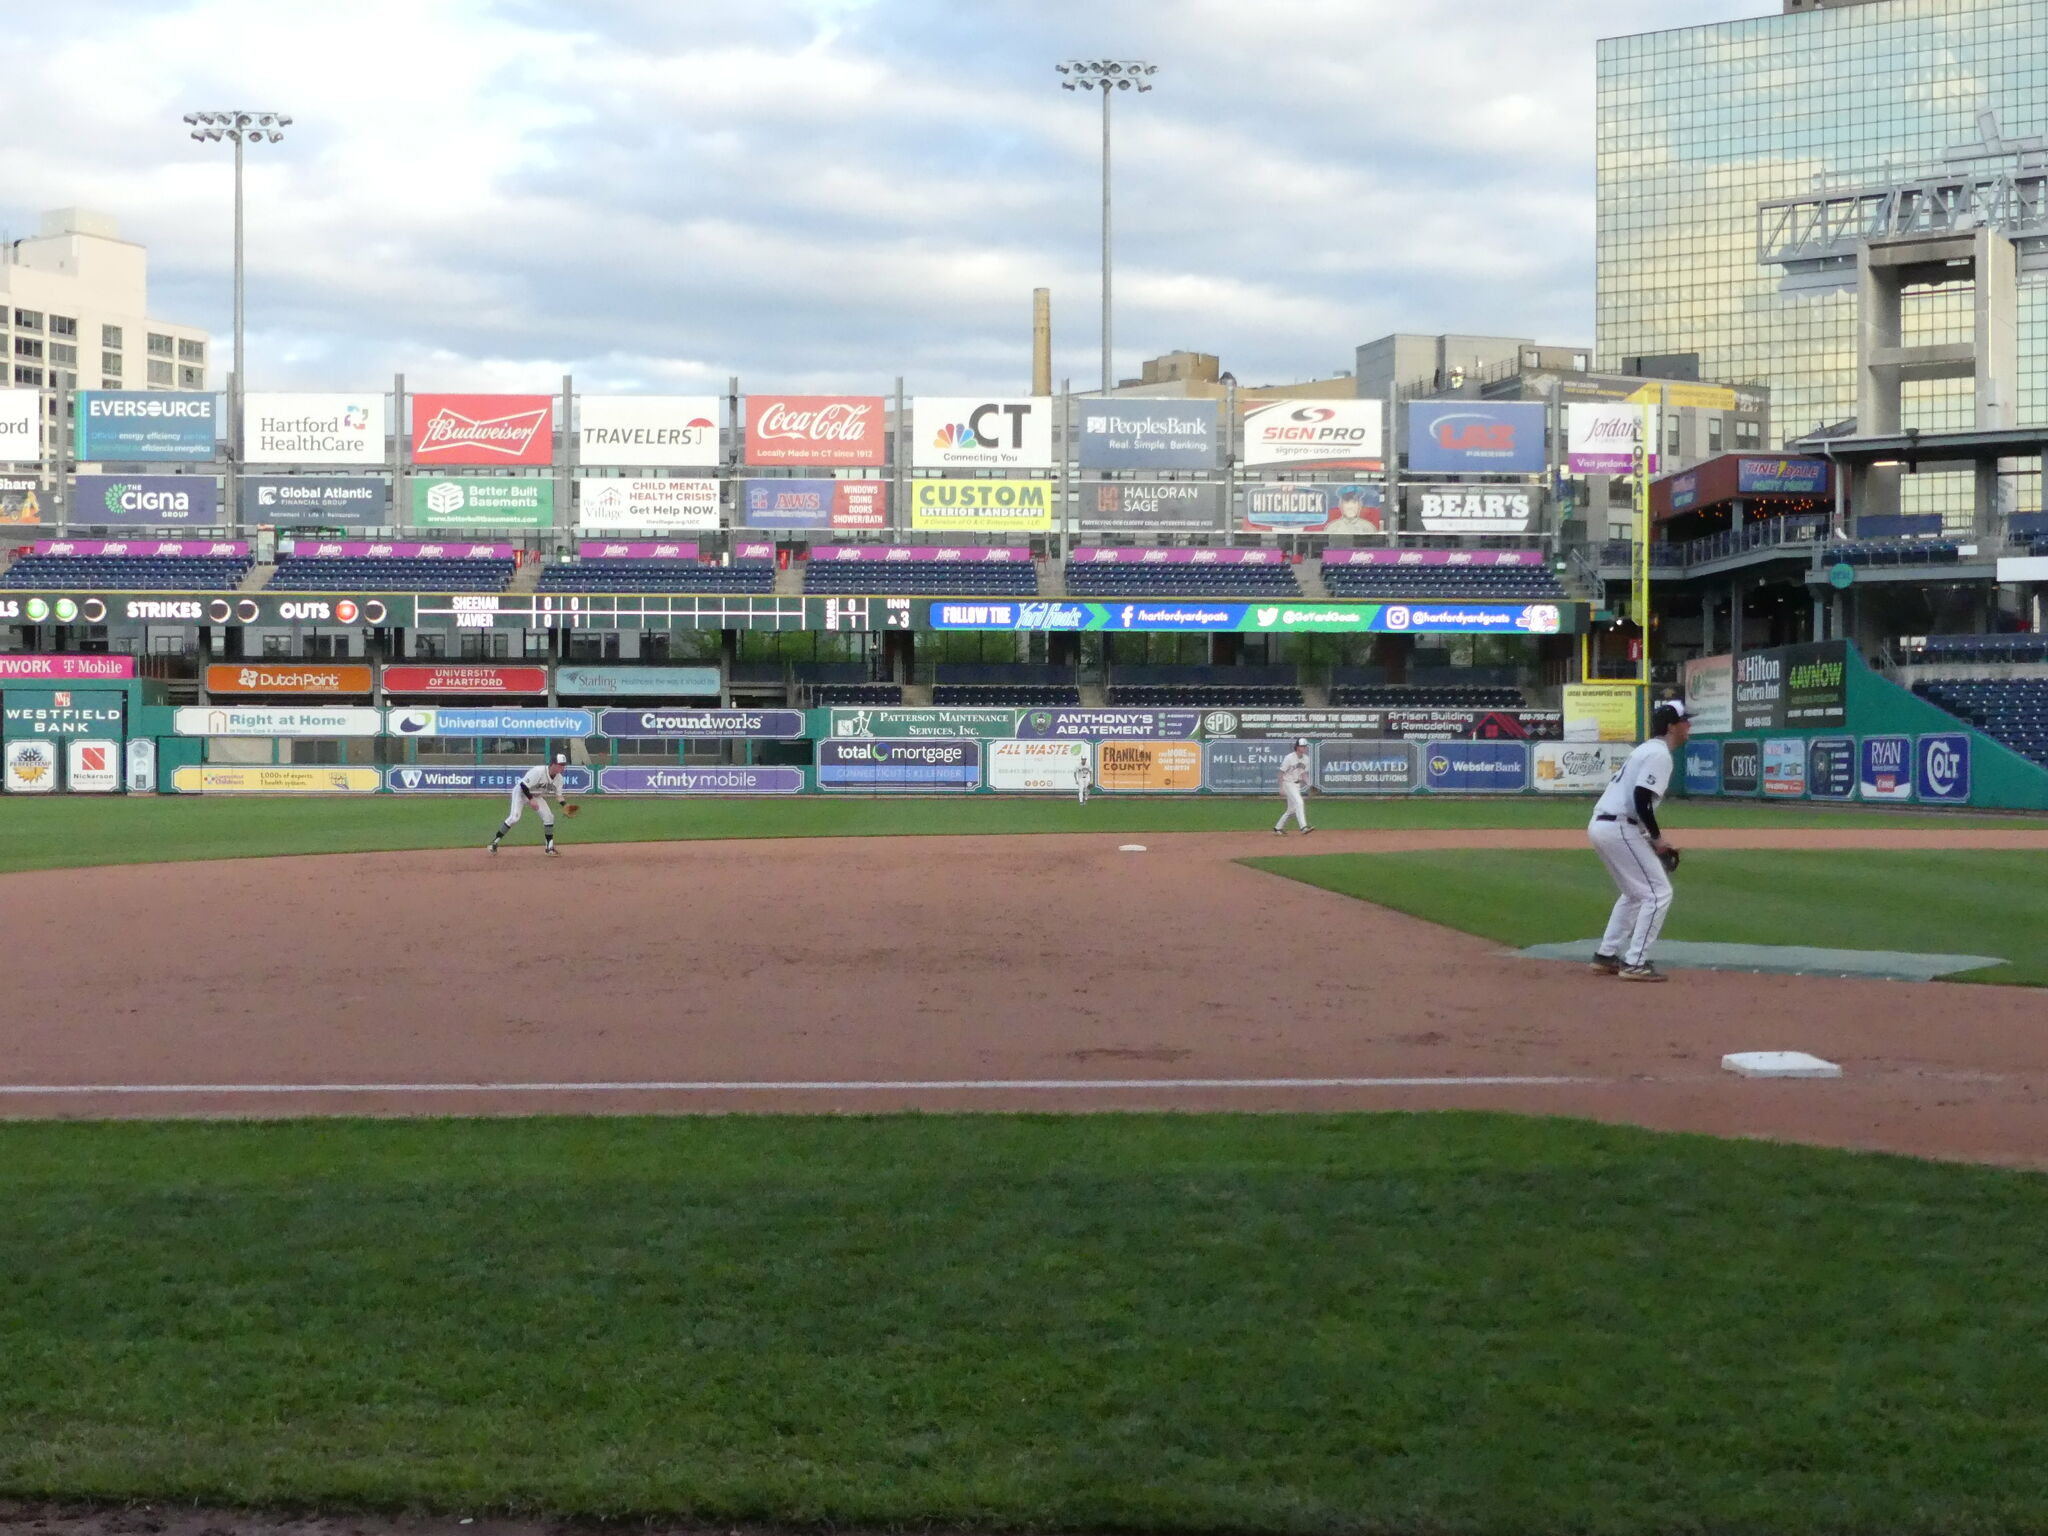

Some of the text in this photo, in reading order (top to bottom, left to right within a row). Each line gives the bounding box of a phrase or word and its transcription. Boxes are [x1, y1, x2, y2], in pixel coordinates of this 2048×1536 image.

[90, 401, 210, 417] EVERSOURCE
[260, 417, 338, 432] Hartford
[757, 403, 872, 440] Coca-Cola
[969, 403, 1032, 448] CT
[1110, 416, 1206, 439] PeoplesBank
[428, 418, 534, 440] Budweiser
[1262, 427, 1366, 440] SIGN PRO
[119, 432, 180, 441] energy efficiency
[584, 428, 692, 444] TRAVELERS
[1440, 424, 1515, 450] LAZ
[260, 435, 364, 451] HealthCare
[1110, 440, 1208, 452] Real. Simple. Banking.
[757, 450, 785, 458] Locally
[788, 450, 809, 458] Made
[821, 450, 832, 458] CT
[834, 450, 854, 458] since
[856, 450, 872, 458] 1912
[944, 453, 1018, 462] Connecting You
[1577, 459, 1596, 467] Visit
[470, 486, 538, 496] Better Built
[632, 482, 714, 490] CHILD MENTAL
[844, 486, 878, 494] WINDOWS
[280, 487, 372, 498] Global Atlantic
[630, 492, 717, 501] HEALTH CRISIS?
[920, 486, 1044, 506] CUSTOM
[1124, 488, 1198, 498] HALLORAN
[470, 497, 538, 507] Basements
[775, 493, 820, 510] AWS
[850, 496, 872, 504] SIDING
[1124, 500, 1158, 512] SAGE
[1254, 492, 1323, 512] HITCHCOCK
[1420, 494, 1530, 518] BEAR'S
[586, 507, 624, 520] Village
[630, 506, 717, 516] Get Help NOW.
[849, 505, 872, 514] DOORS
[921, 508, 1044, 517] EXTERIOR LANDSCAPE
[453, 596, 856, 612] SHEEHAN 0 0 0
[886, 598, 910, 608] INN
[127, 602, 202, 618] STRIKES
[280, 602, 330, 619] OUTS
[826, 598, 836, 630] RUNS
[943, 606, 988, 624] FOLLOW
[456, 614, 856, 628] XAVIER 0 1 1
[900, 611, 910, 628] 3
[1412, 612, 1510, 626] @hartfordyardgoats
[78, 660, 122, 674] Mobile
[1746, 655, 1780, 682] Hilton
[430, 678, 502, 686] OF HARTFORD
[1737, 683, 1764, 702] Garden
[1766, 682, 1780, 699] Inn
[6, 710, 120, 719] WESTFIELD
[230, 714, 346, 726] Right at Home
[880, 712, 1008, 722] PATTERSON MAINTENANCE
[1056, 714, 1153, 724] ANTHONY'S
[1388, 712, 1474, 722] Artisan Building
[34, 722, 88, 732] BANK
[438, 717, 582, 731] Universal Connectivity
[642, 714, 761, 728] Groundworks
[1402, 722, 1462, 732] Remodeling
[1056, 726, 1153, 735] ABATEMENT
[838, 744, 962, 762] total mortgage
[997, 744, 1070, 756] ALL WASTE
[1872, 742, 1900, 764] RYAN
[1324, 761, 1408, 772] AUTOMATED
[425, 774, 474, 785] Windsor
[647, 772, 756, 788] xfinity mobile
[1325, 774, 1408, 782] BUSINESS SOLUTIONS
